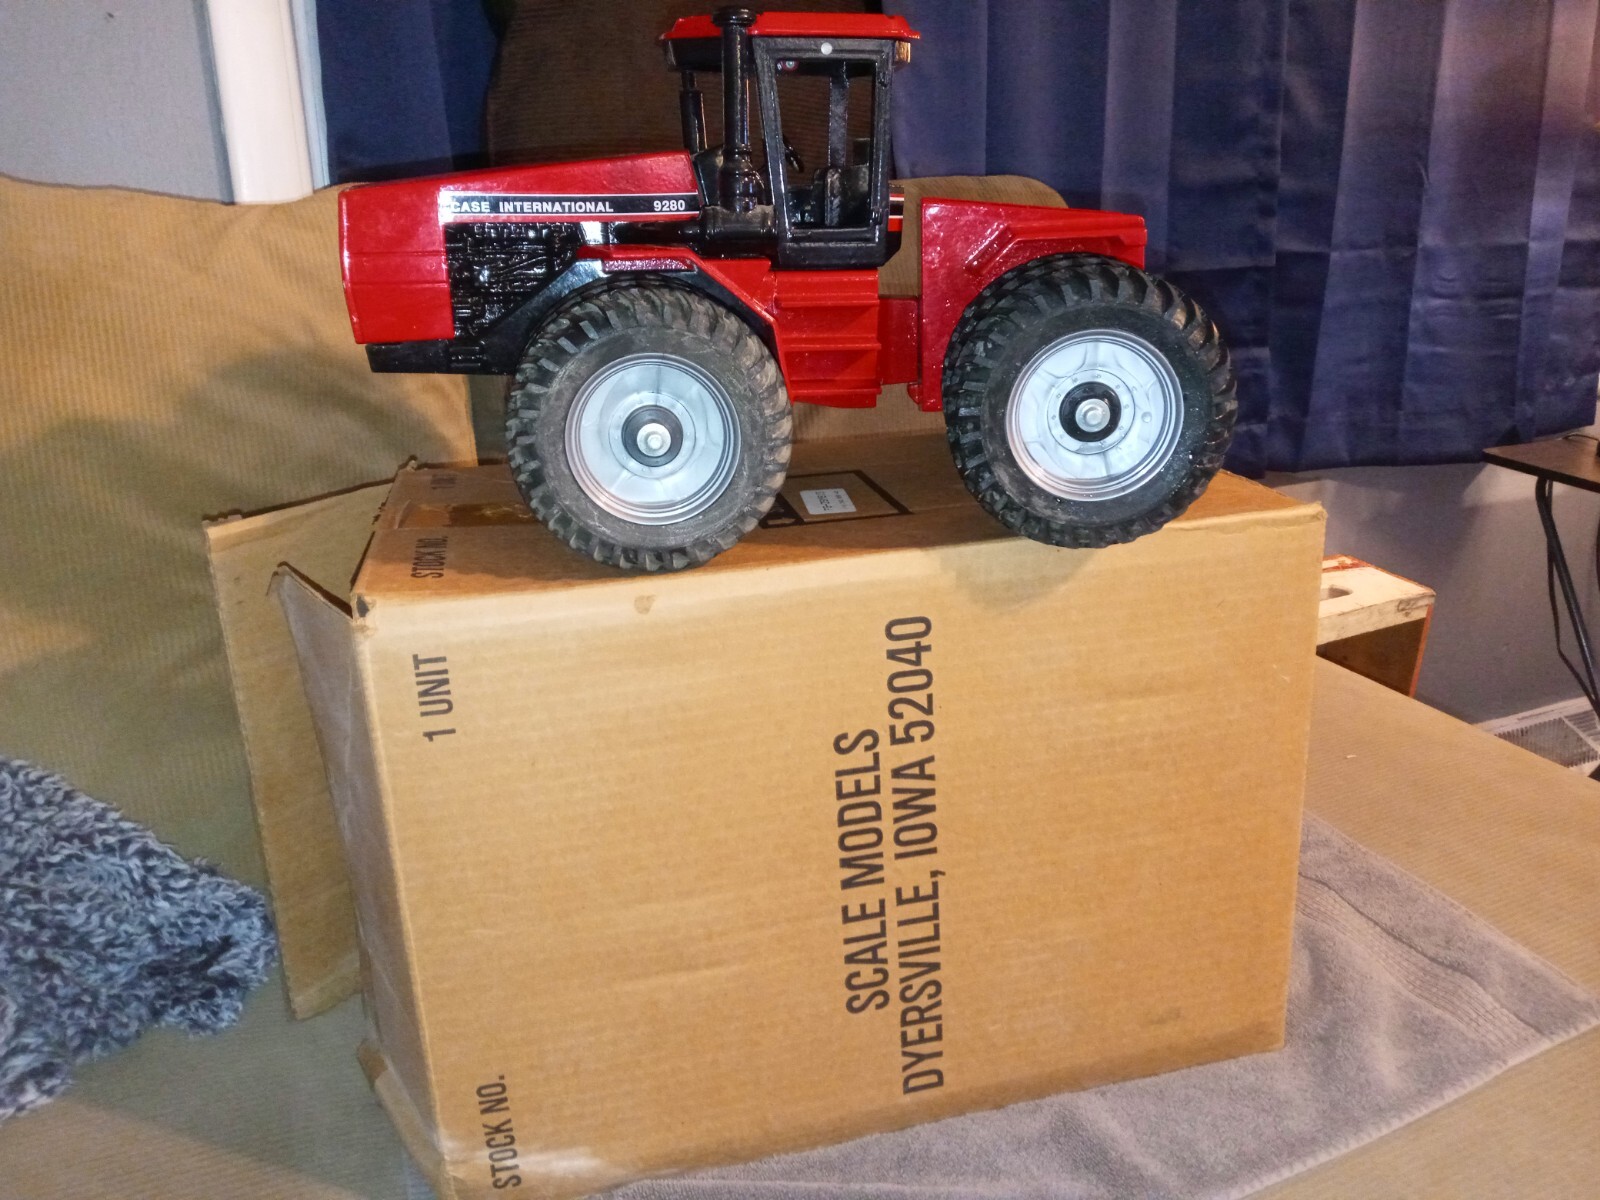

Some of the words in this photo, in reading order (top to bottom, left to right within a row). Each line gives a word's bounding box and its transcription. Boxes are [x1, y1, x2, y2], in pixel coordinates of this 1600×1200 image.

[450, 201, 490, 213] CASE
[499, 200, 614, 213] INTERNATIONAL
[652, 199, 686, 212] 9280
[410, 549, 446, 578] STOCK
[412, 654, 453, 717] UNIT
[885, 616, 935, 746] 52040
[422, 728, 456, 742] 1
[833, 728, 885, 890] MODELS
[891, 755, 938, 860] IOWA
[841, 898, 890, 1014] SCALE
[895, 869, 946, 1095] DYERSVILLE,
[475, 1074, 510, 1115] NO.
[482, 1118, 522, 1190] STOCK
